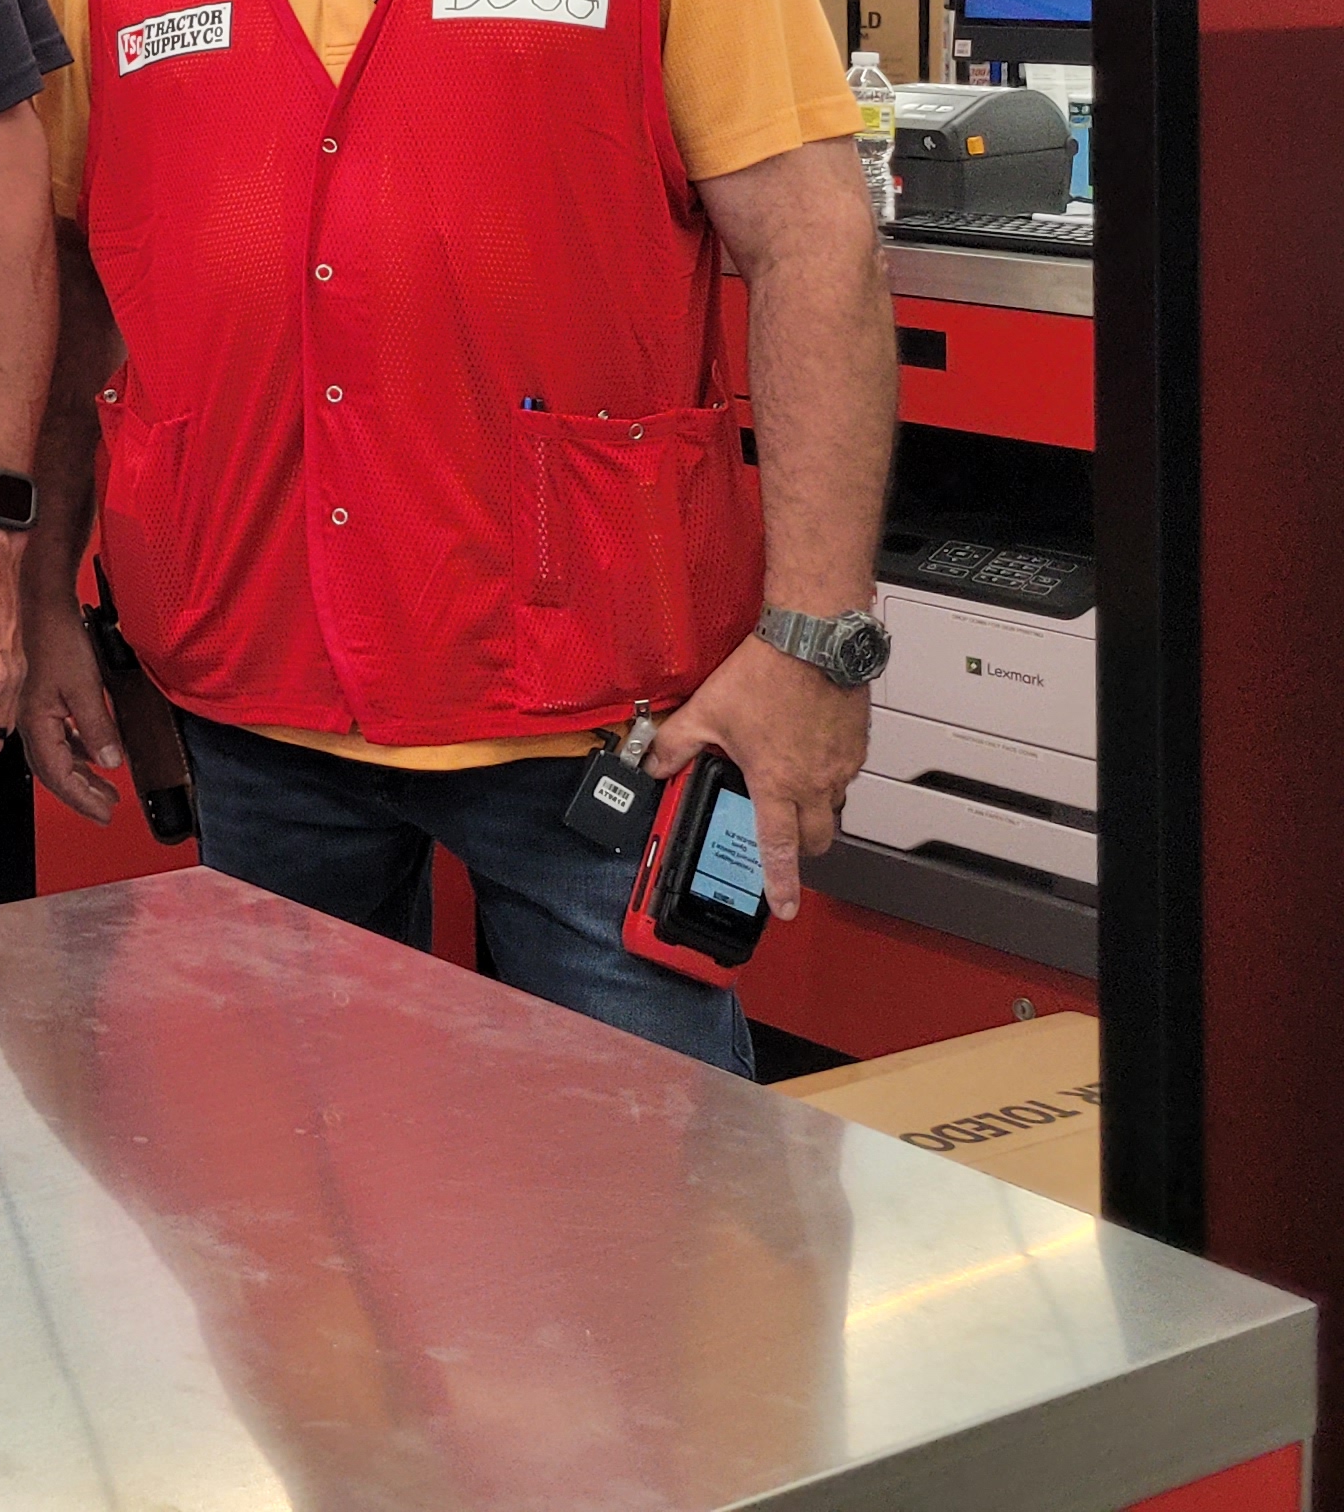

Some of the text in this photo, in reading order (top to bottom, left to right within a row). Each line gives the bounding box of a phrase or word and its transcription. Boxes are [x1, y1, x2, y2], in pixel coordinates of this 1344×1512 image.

[145, 8, 224, 37] TRACTOR
[124, 32, 144, 56] TSC
[144, 30, 202, 59] SUPPLY
[987, 662, 1044, 687] Lexmark
[899, 1100, 1083, 1152] TOLEDO
